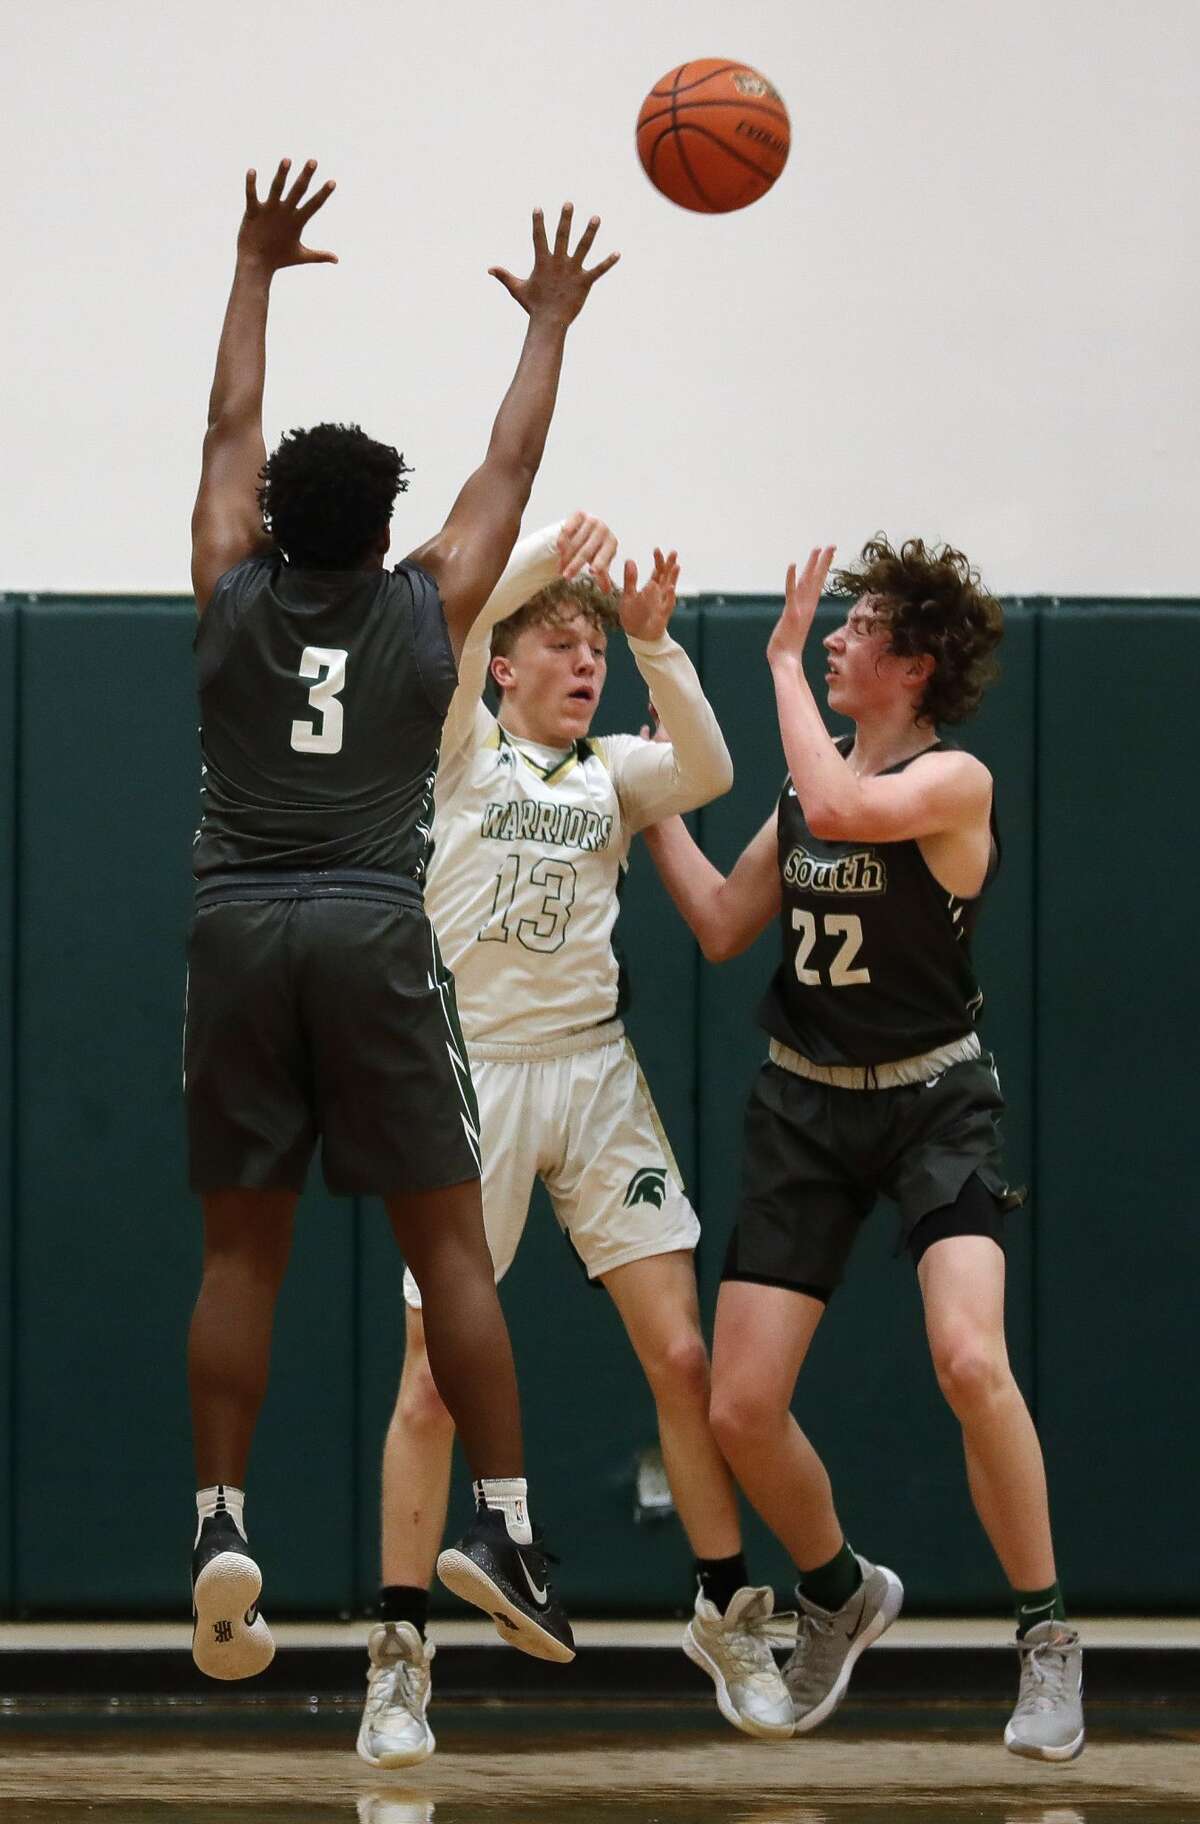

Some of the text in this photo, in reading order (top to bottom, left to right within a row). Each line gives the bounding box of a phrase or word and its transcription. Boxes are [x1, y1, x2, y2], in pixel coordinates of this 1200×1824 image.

[290, 646, 348, 754] 3
[481, 799, 613, 852] WARRIORS
[478, 854, 577, 953] 13
[784, 845, 885, 894] South
[792, 908, 871, 986] 22
